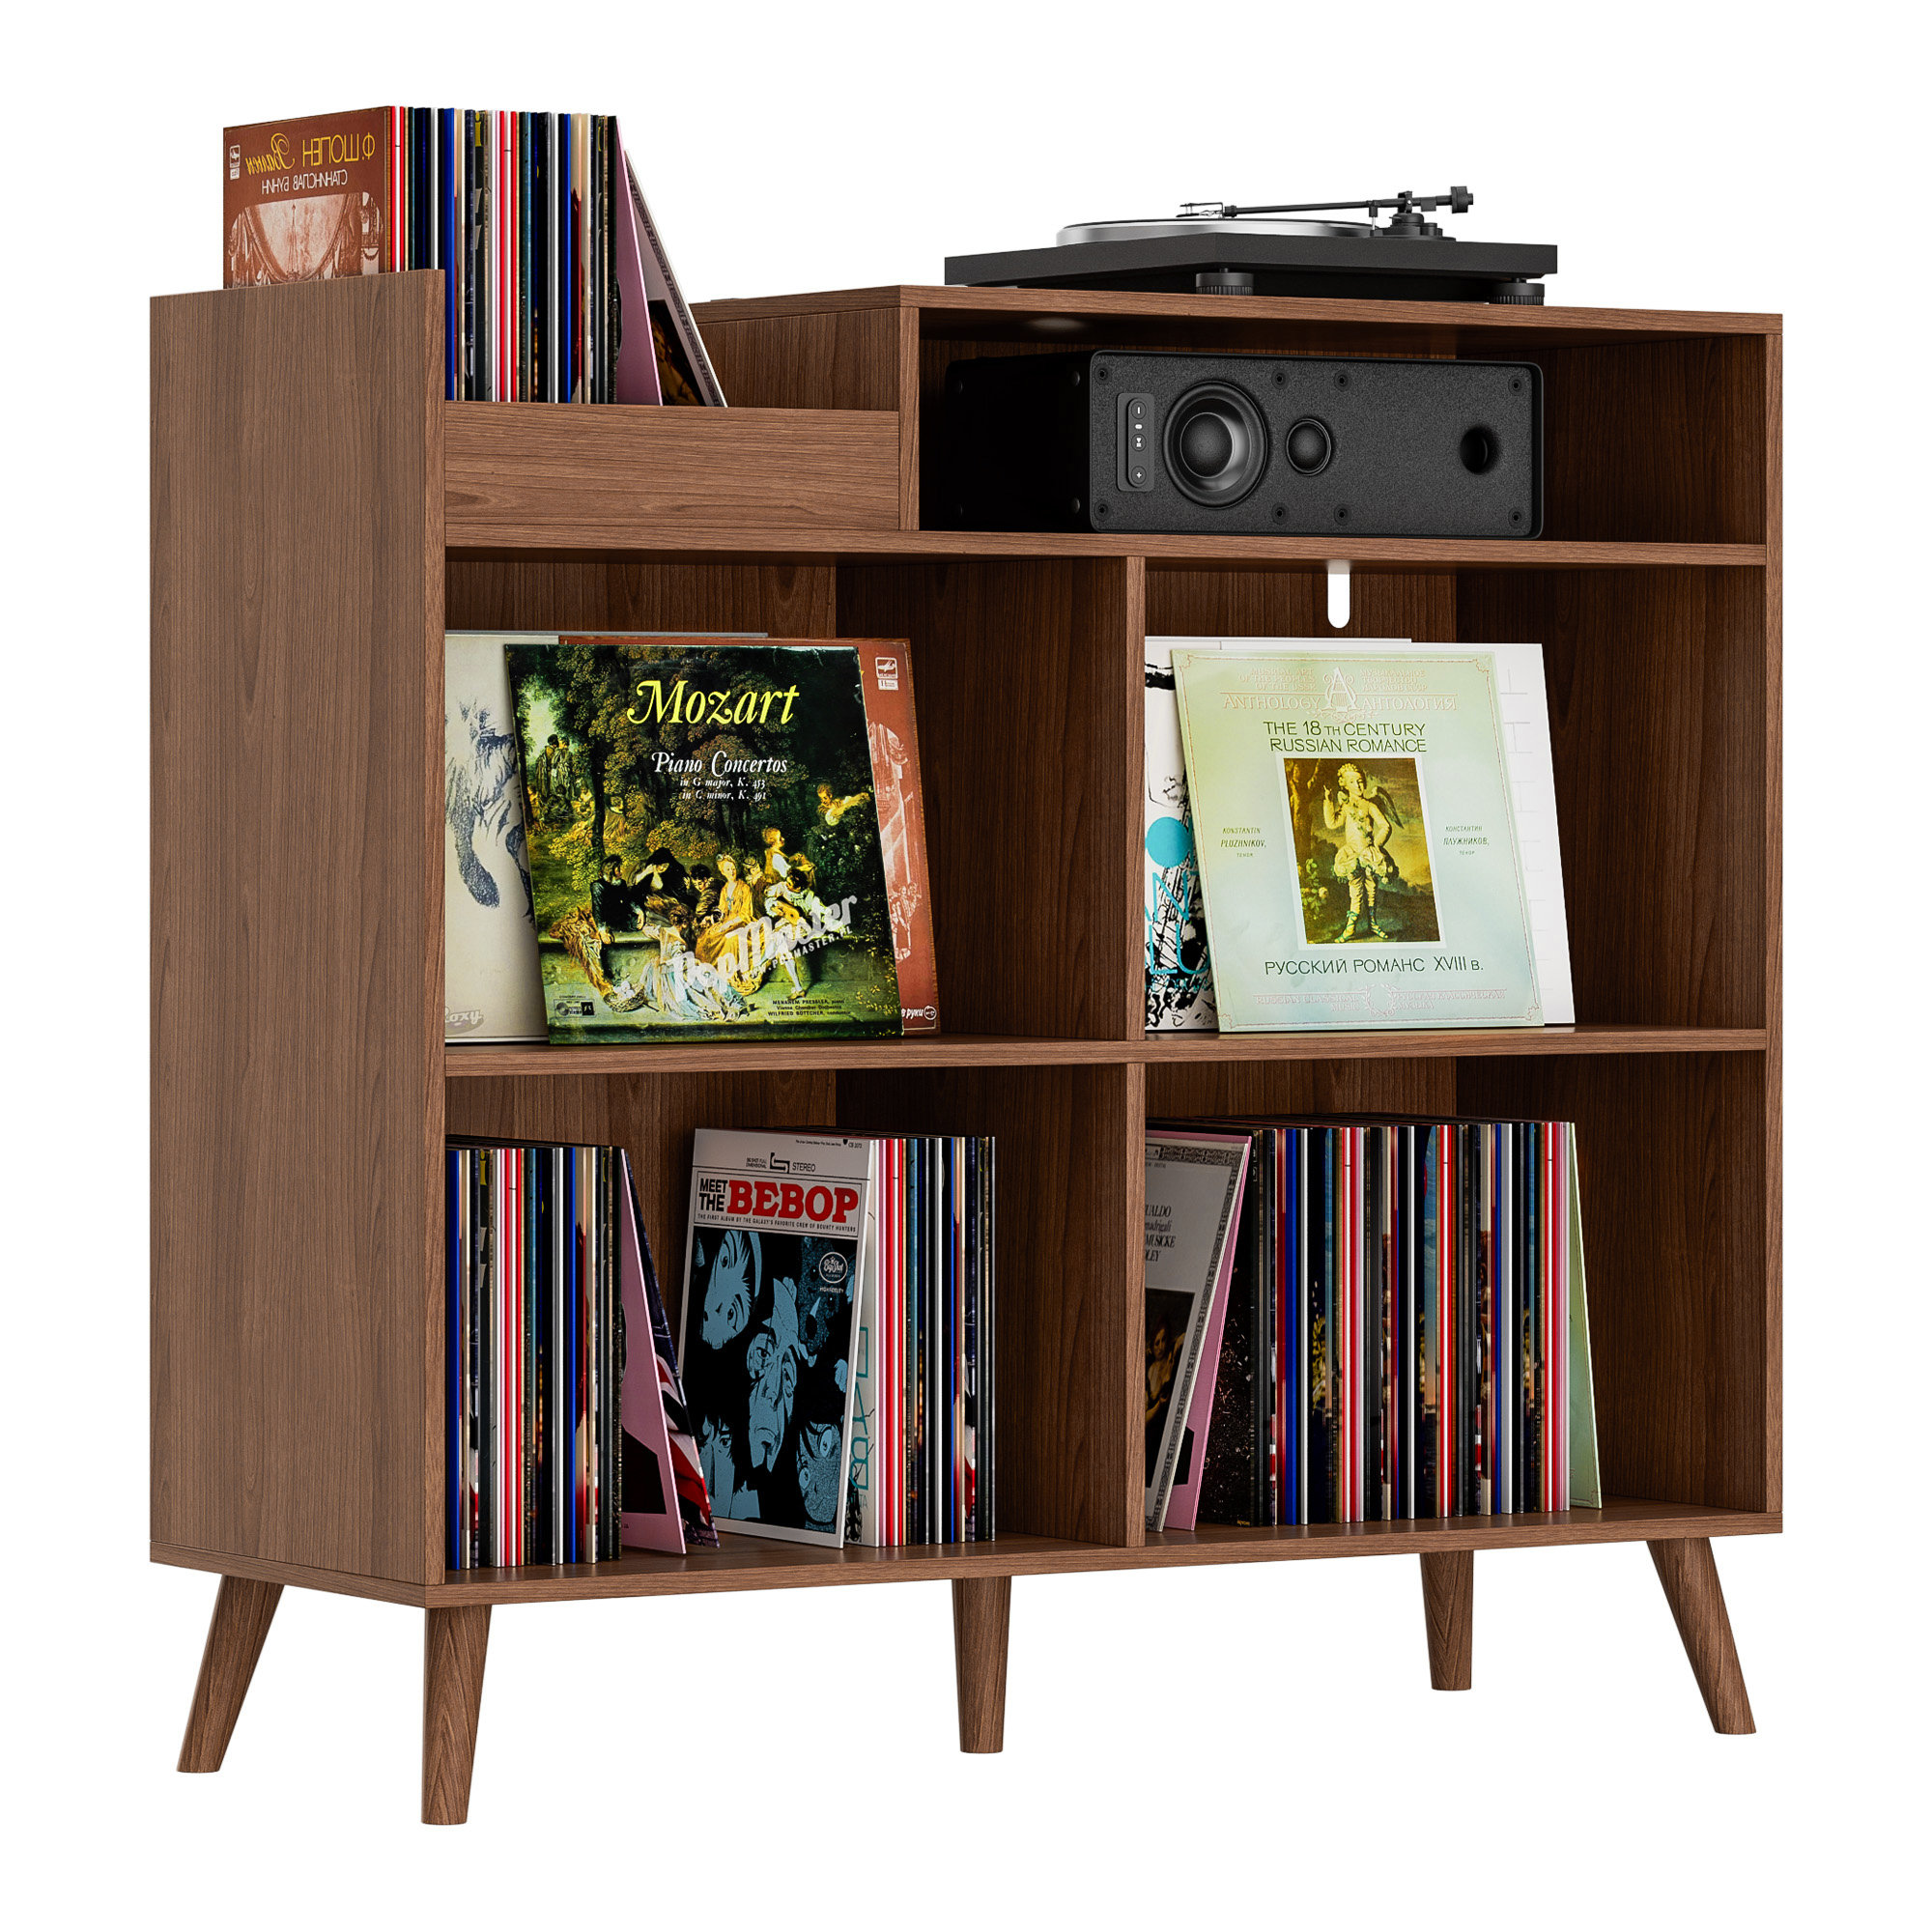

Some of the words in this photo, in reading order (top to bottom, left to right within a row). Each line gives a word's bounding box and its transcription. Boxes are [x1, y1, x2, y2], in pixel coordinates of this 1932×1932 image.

[627, 680, 800, 724] Mozart
[1223, 695, 1321, 710] ANTHOLOGY
[1362, 696, 1458, 711] АНТОЛОГИЯ
[1264, 722, 1298, 735] THE
[1303, 720, 1321, 736] 18
[1344, 723, 1426, 736] CENTURY
[1270, 738, 1342, 753] RUSSIAN
[1347, 739, 1427, 753] ROMANCE
[651, 752, 702, 774] Piano
[711, 750, 788, 777] Concertos
[1264, 958, 1348, 975] РУССКИЙ
[1353, 957, 1426, 973] РОМАНС
[1434, 955, 1467, 972] XVIII
[792, 1162, 816, 1172] STEREO
[699, 1178, 728, 1194] MEET
[698, 1193, 725, 1211] THE
[726, 1179, 859, 1224] BEBOP
